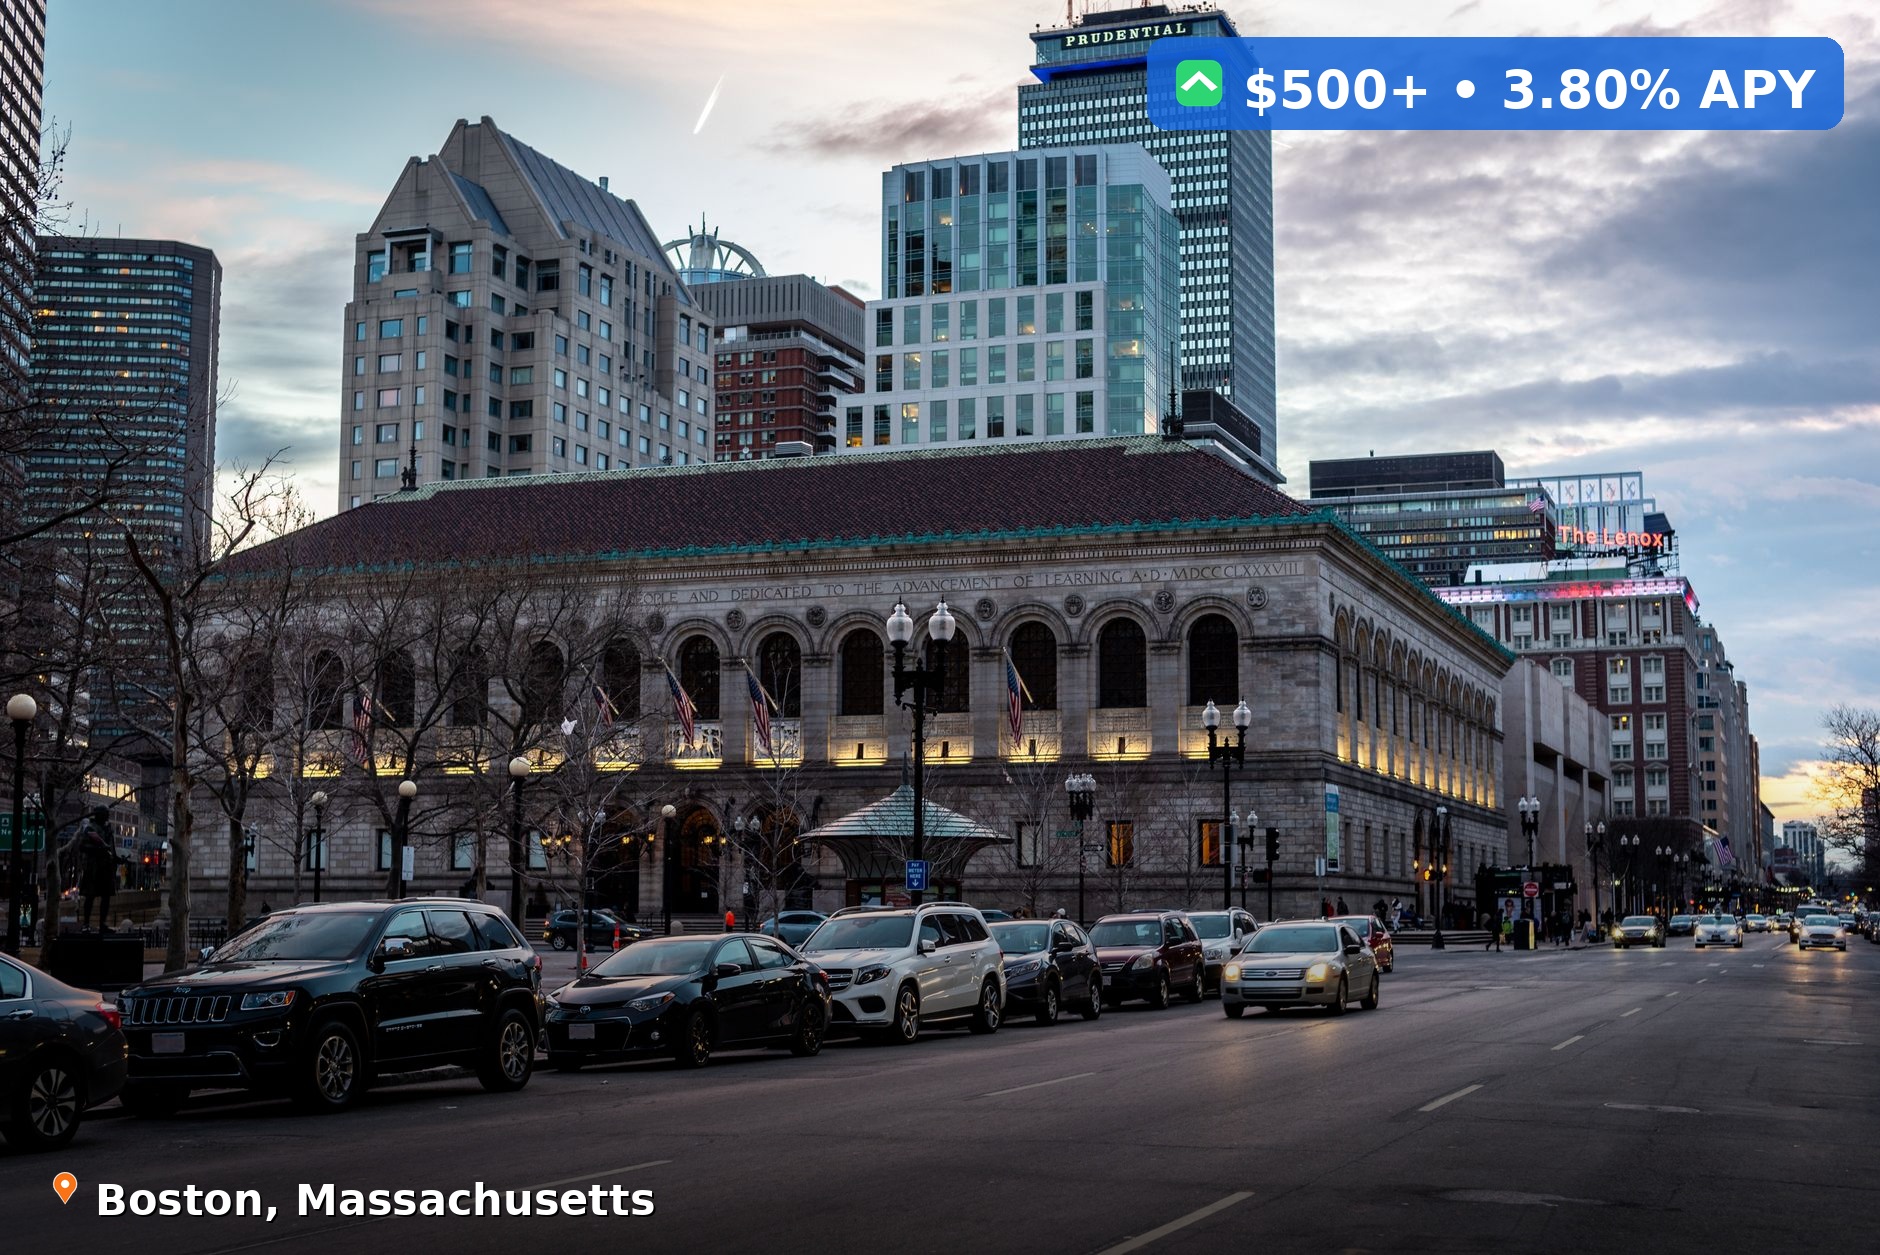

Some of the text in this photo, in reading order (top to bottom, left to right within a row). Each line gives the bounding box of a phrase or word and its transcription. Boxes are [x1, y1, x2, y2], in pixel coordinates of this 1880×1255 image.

[1065, 23, 1186, 46] PRUDENTIAL
[1558, 525, 1664, 547] The Lenox
[690, 590, 719, 602] AND
[731, 586, 812, 601] DEDICATED
[824, 584, 844, 596] TO
[854, 582, 883, 594] THE
[892, 576, 1002, 593] ADVANCEMENT
[1013, 575, 1034, 588] OF
[1045, 570, 1123, 586] LEARNING
